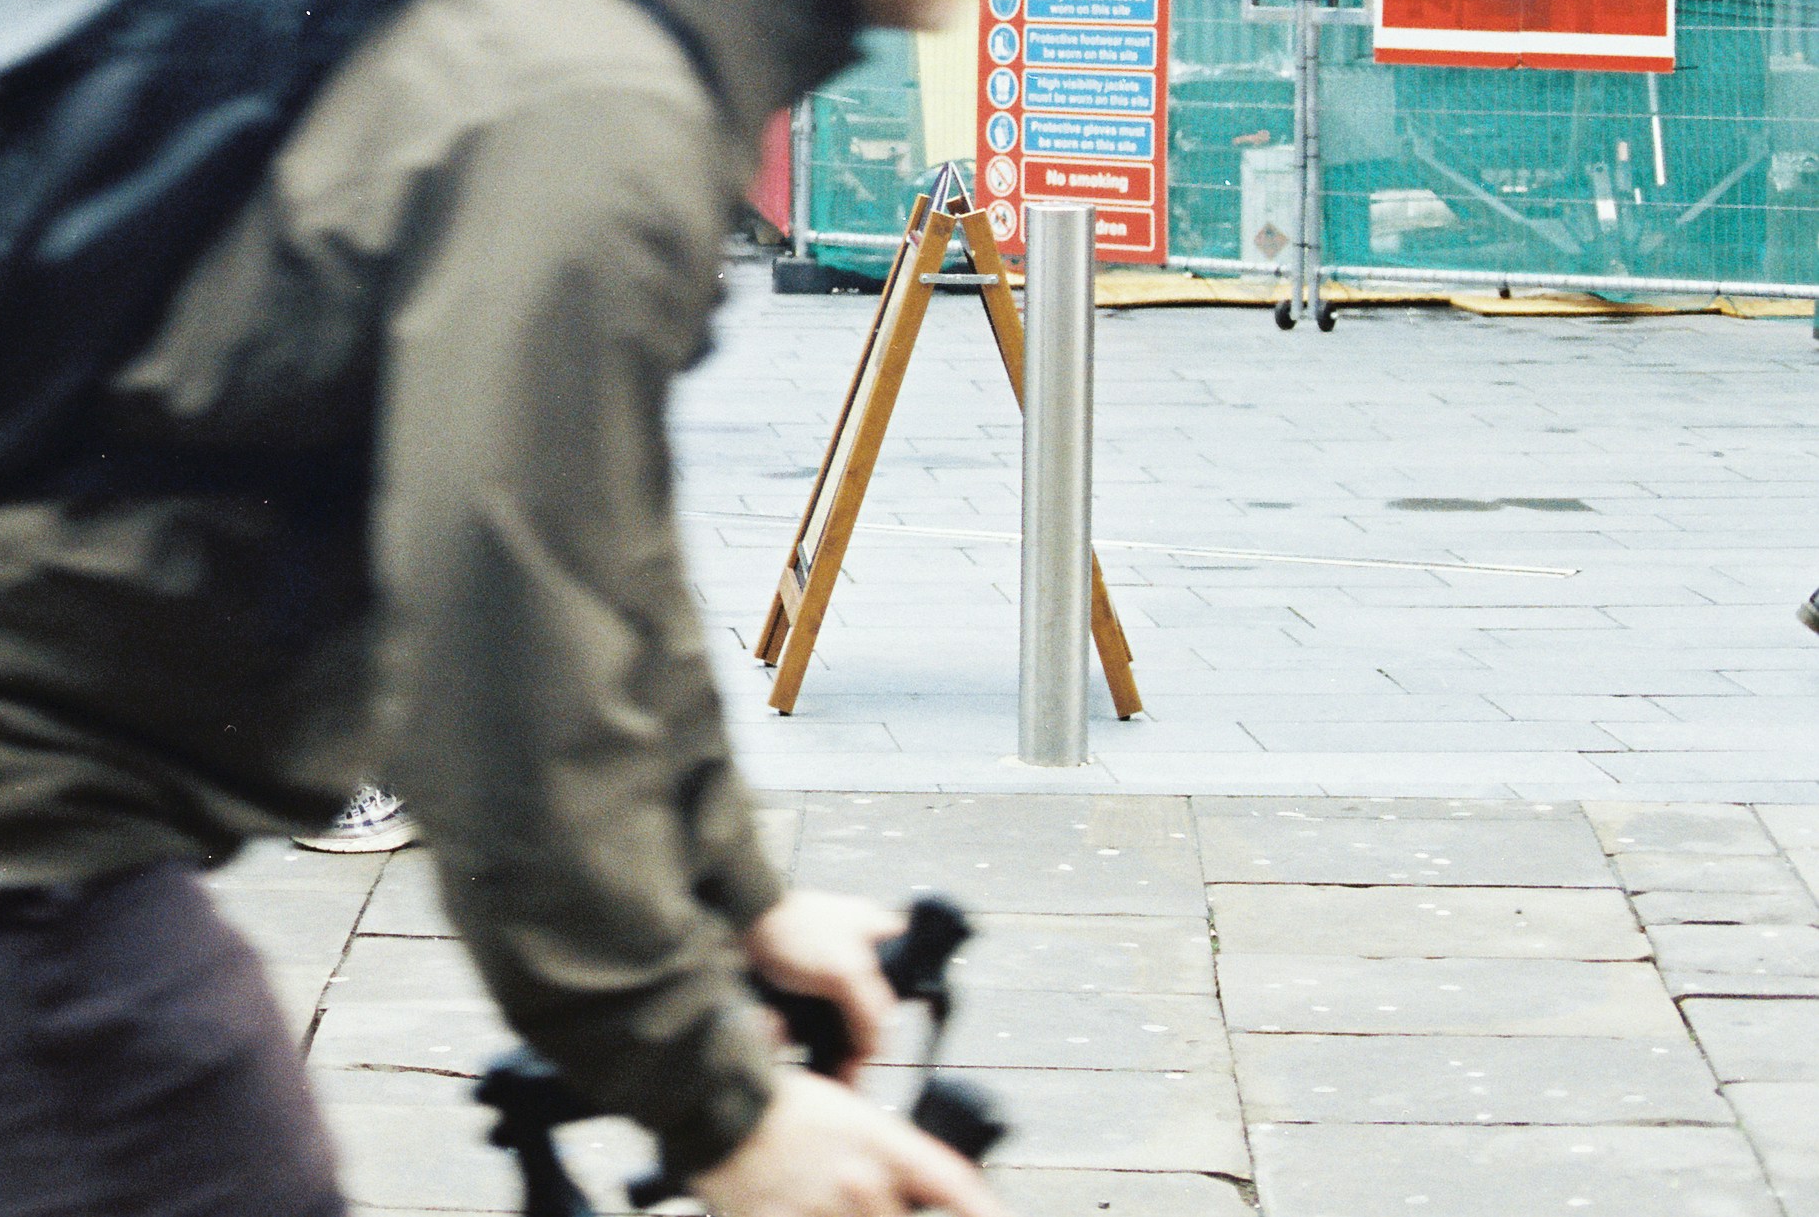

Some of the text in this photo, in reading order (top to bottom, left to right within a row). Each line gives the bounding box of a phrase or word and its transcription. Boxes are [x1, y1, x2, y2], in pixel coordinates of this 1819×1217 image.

[1050, 4, 1131, 16] worn on this site
[1029, 32, 1078, 45] Protective
[1124, 36, 1150, 47] must
[1043, 47, 1139, 61] be worn on this site
[1037, 78, 1140, 93] High visibility jackets
[1028, 92, 1149, 107] must be worn on this site
[1031, 121, 1146, 137] Protective gloves must
[1038, 136, 1137, 152] be worn on this site
[1045, 169, 1129, 193] No smoking
[1095, 218, 1127, 236] dren
